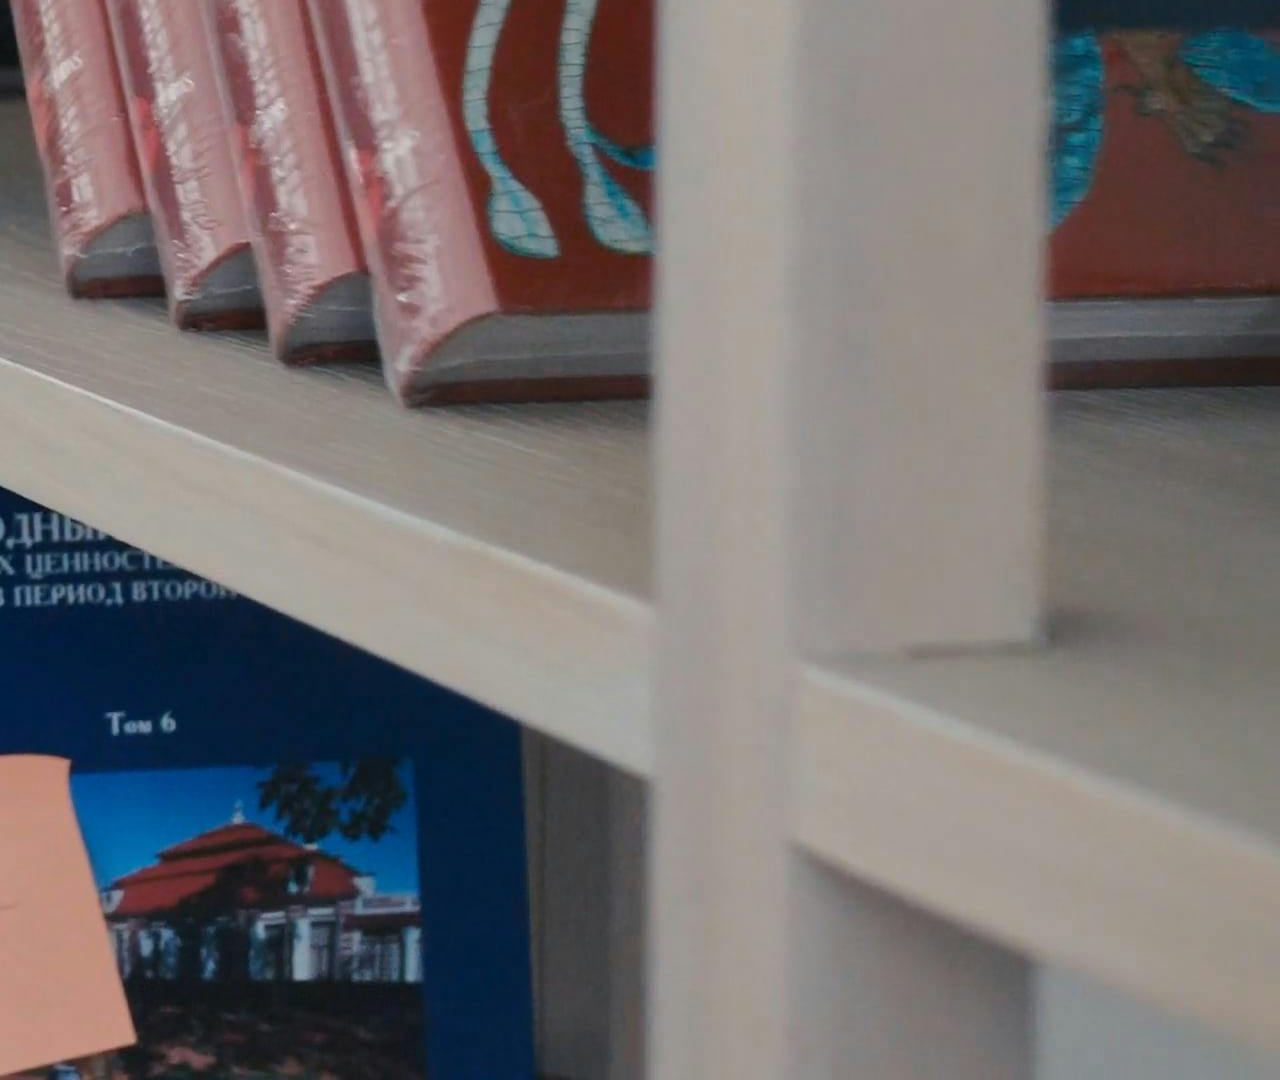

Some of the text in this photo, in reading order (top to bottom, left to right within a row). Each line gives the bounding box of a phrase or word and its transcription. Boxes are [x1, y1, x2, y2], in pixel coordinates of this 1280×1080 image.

[13, 580, 124, 607] ПЕРИОД
[104, 710, 177, 736] Том 6
